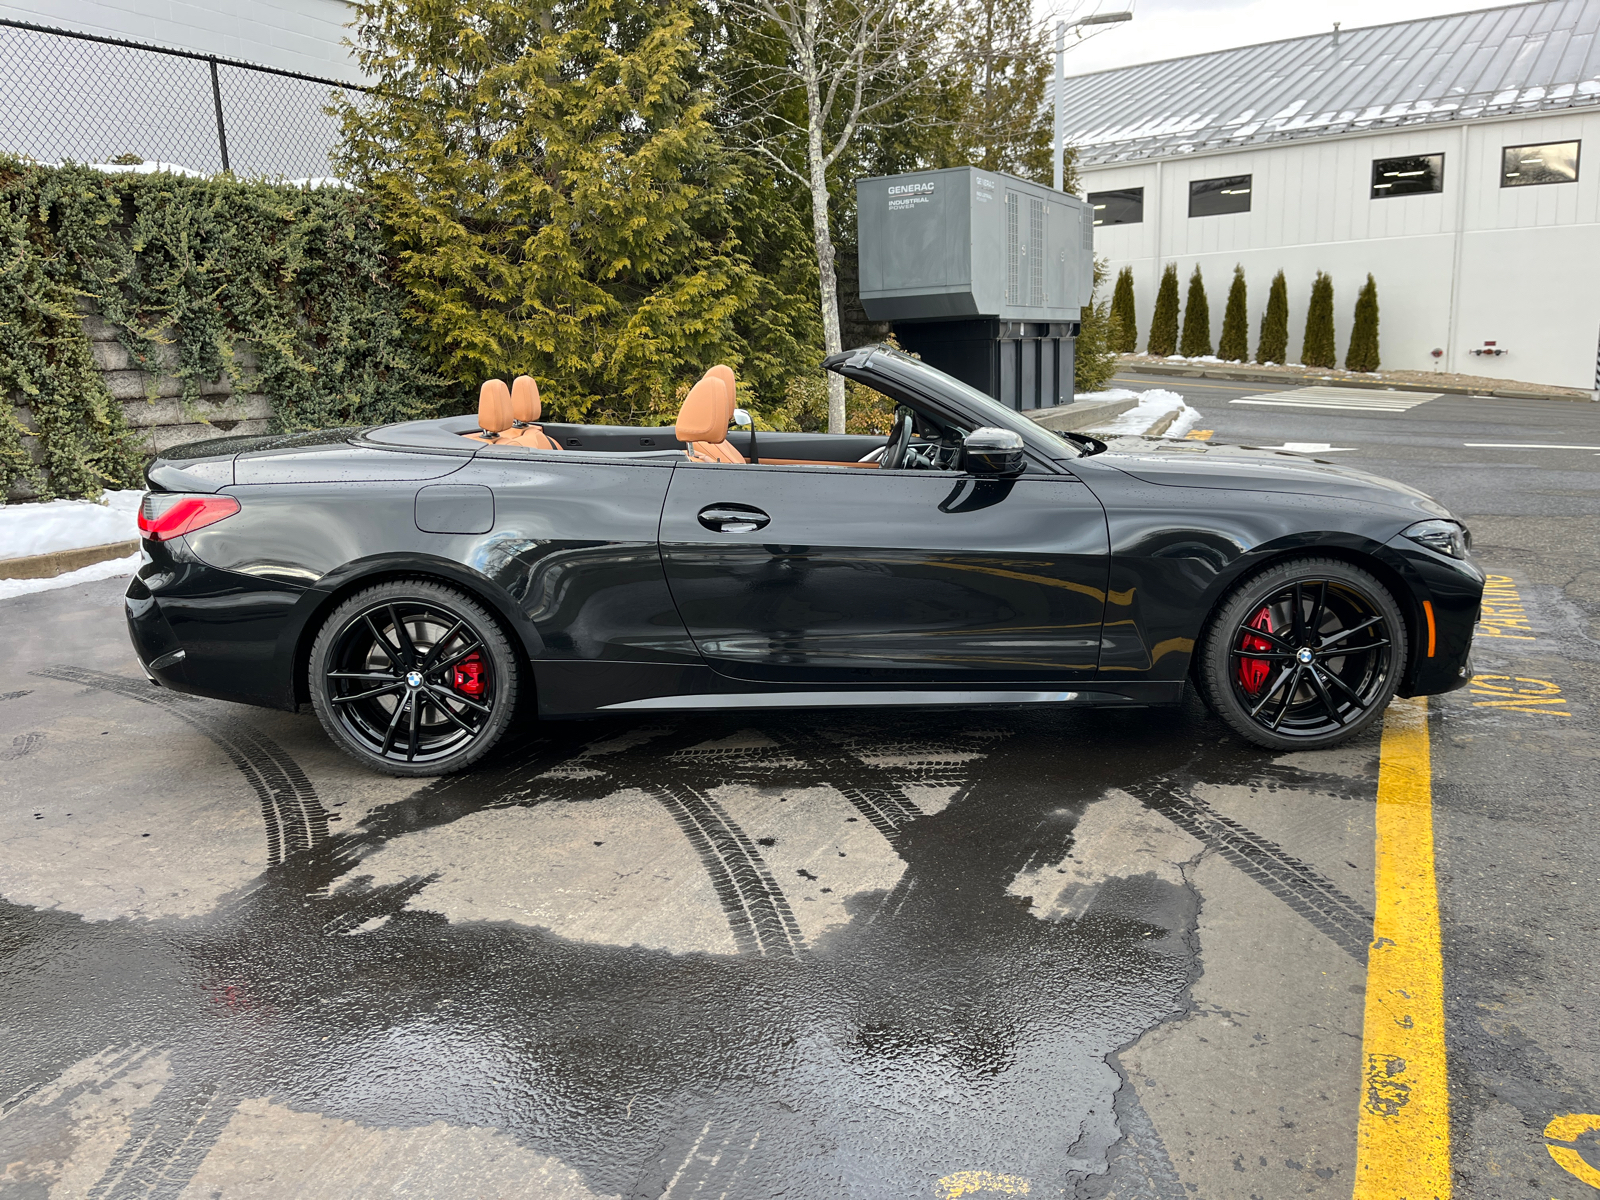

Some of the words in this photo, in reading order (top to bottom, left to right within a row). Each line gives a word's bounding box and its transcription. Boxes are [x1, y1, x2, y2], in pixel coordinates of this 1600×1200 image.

[888, 182, 935, 195] GENERAC
[888, 197, 929, 206] INDUSTRIAL
[888, 203, 915, 211] POWER
[1469, 675, 1572, 717] NO
